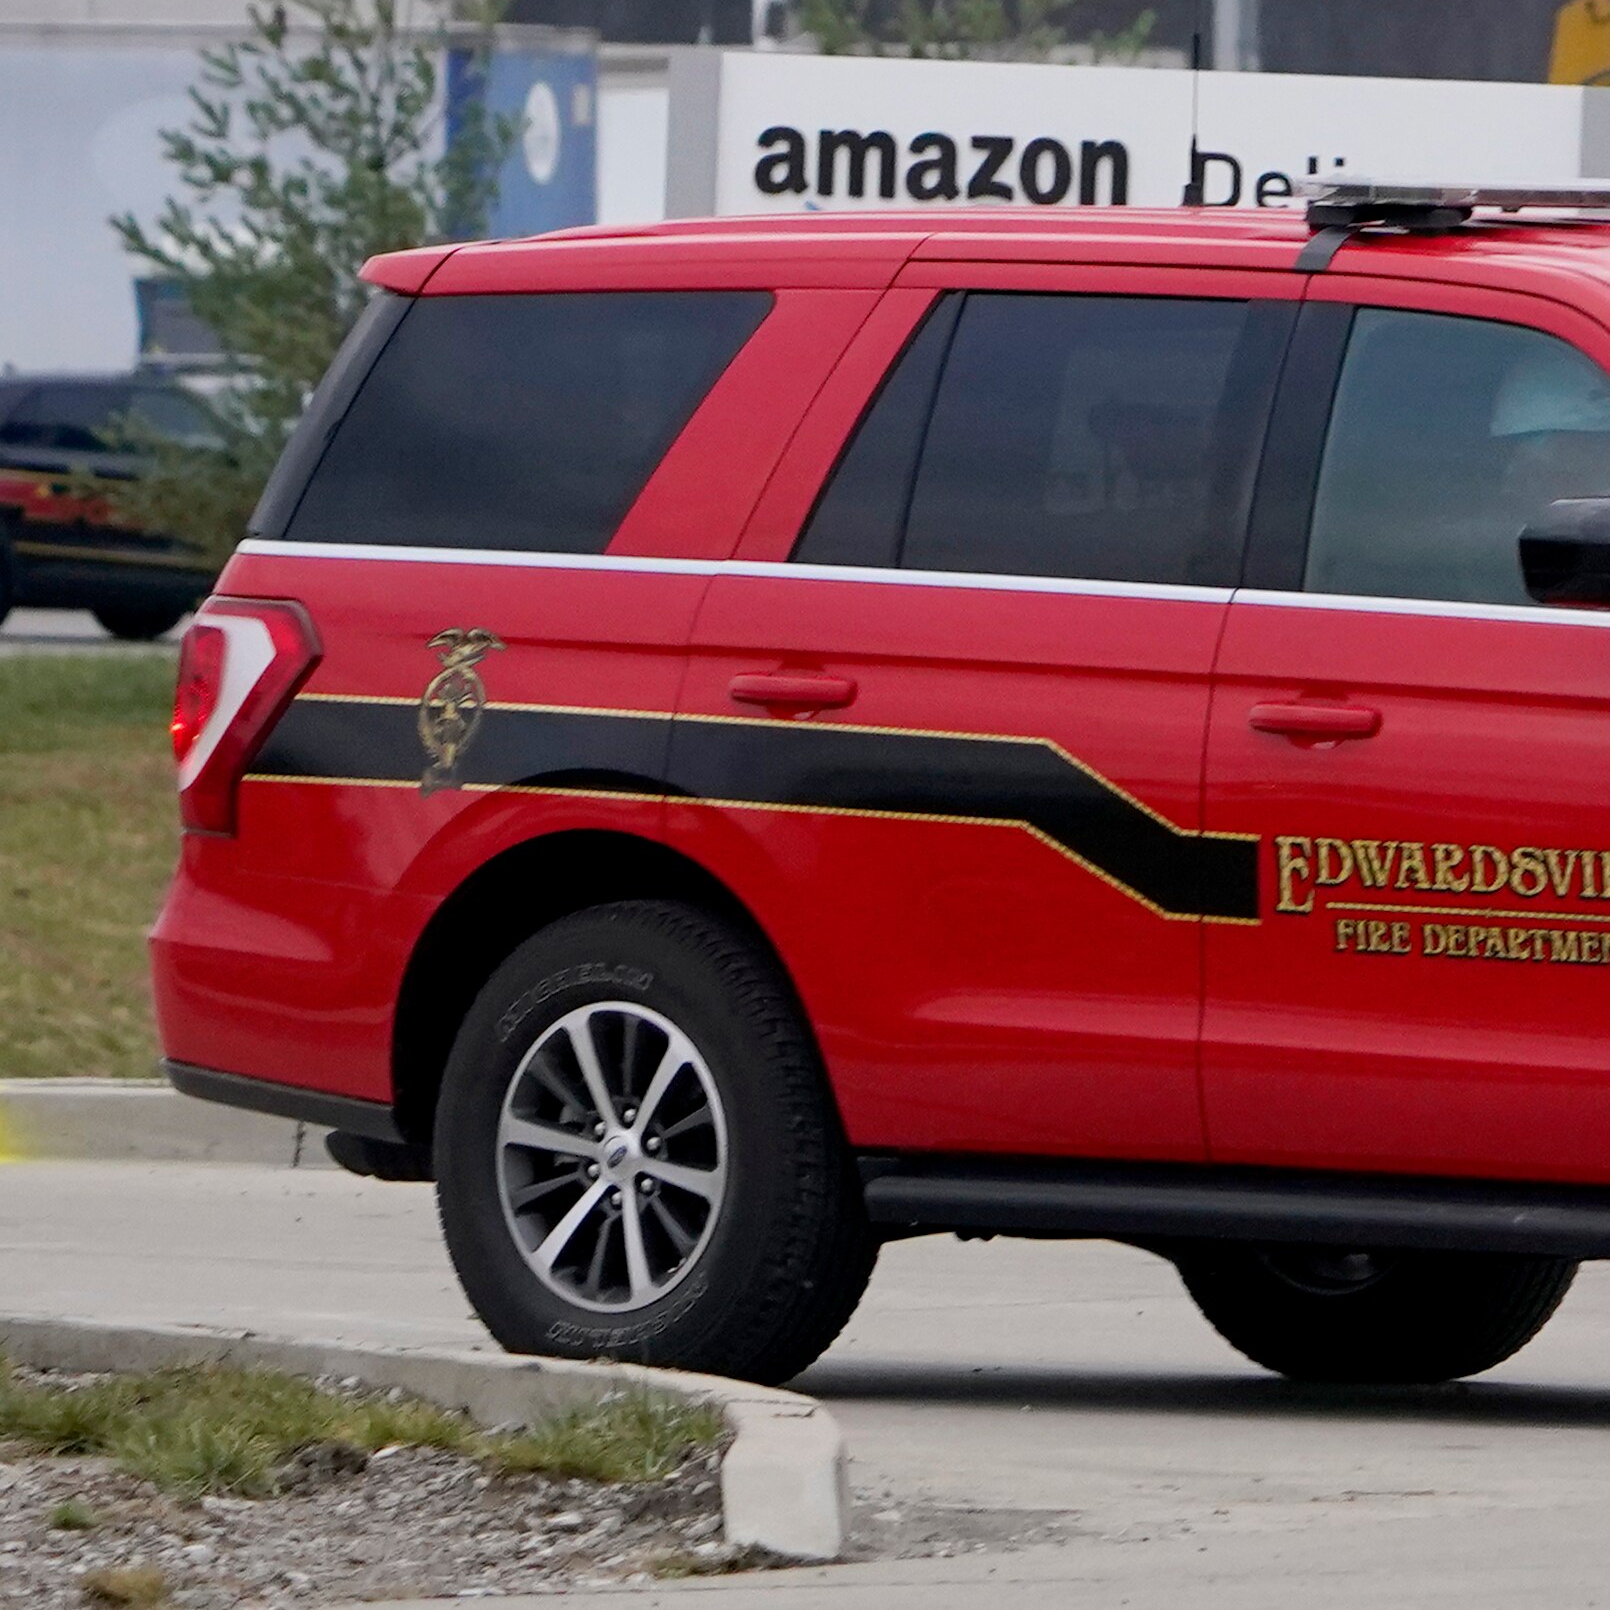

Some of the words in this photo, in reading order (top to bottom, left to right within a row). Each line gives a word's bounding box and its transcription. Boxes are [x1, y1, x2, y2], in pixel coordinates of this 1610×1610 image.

[754, 125, 1129, 206] amazon
[1192, 151, 1345, 208] De
[1334, 918, 1412, 955] FIRE
